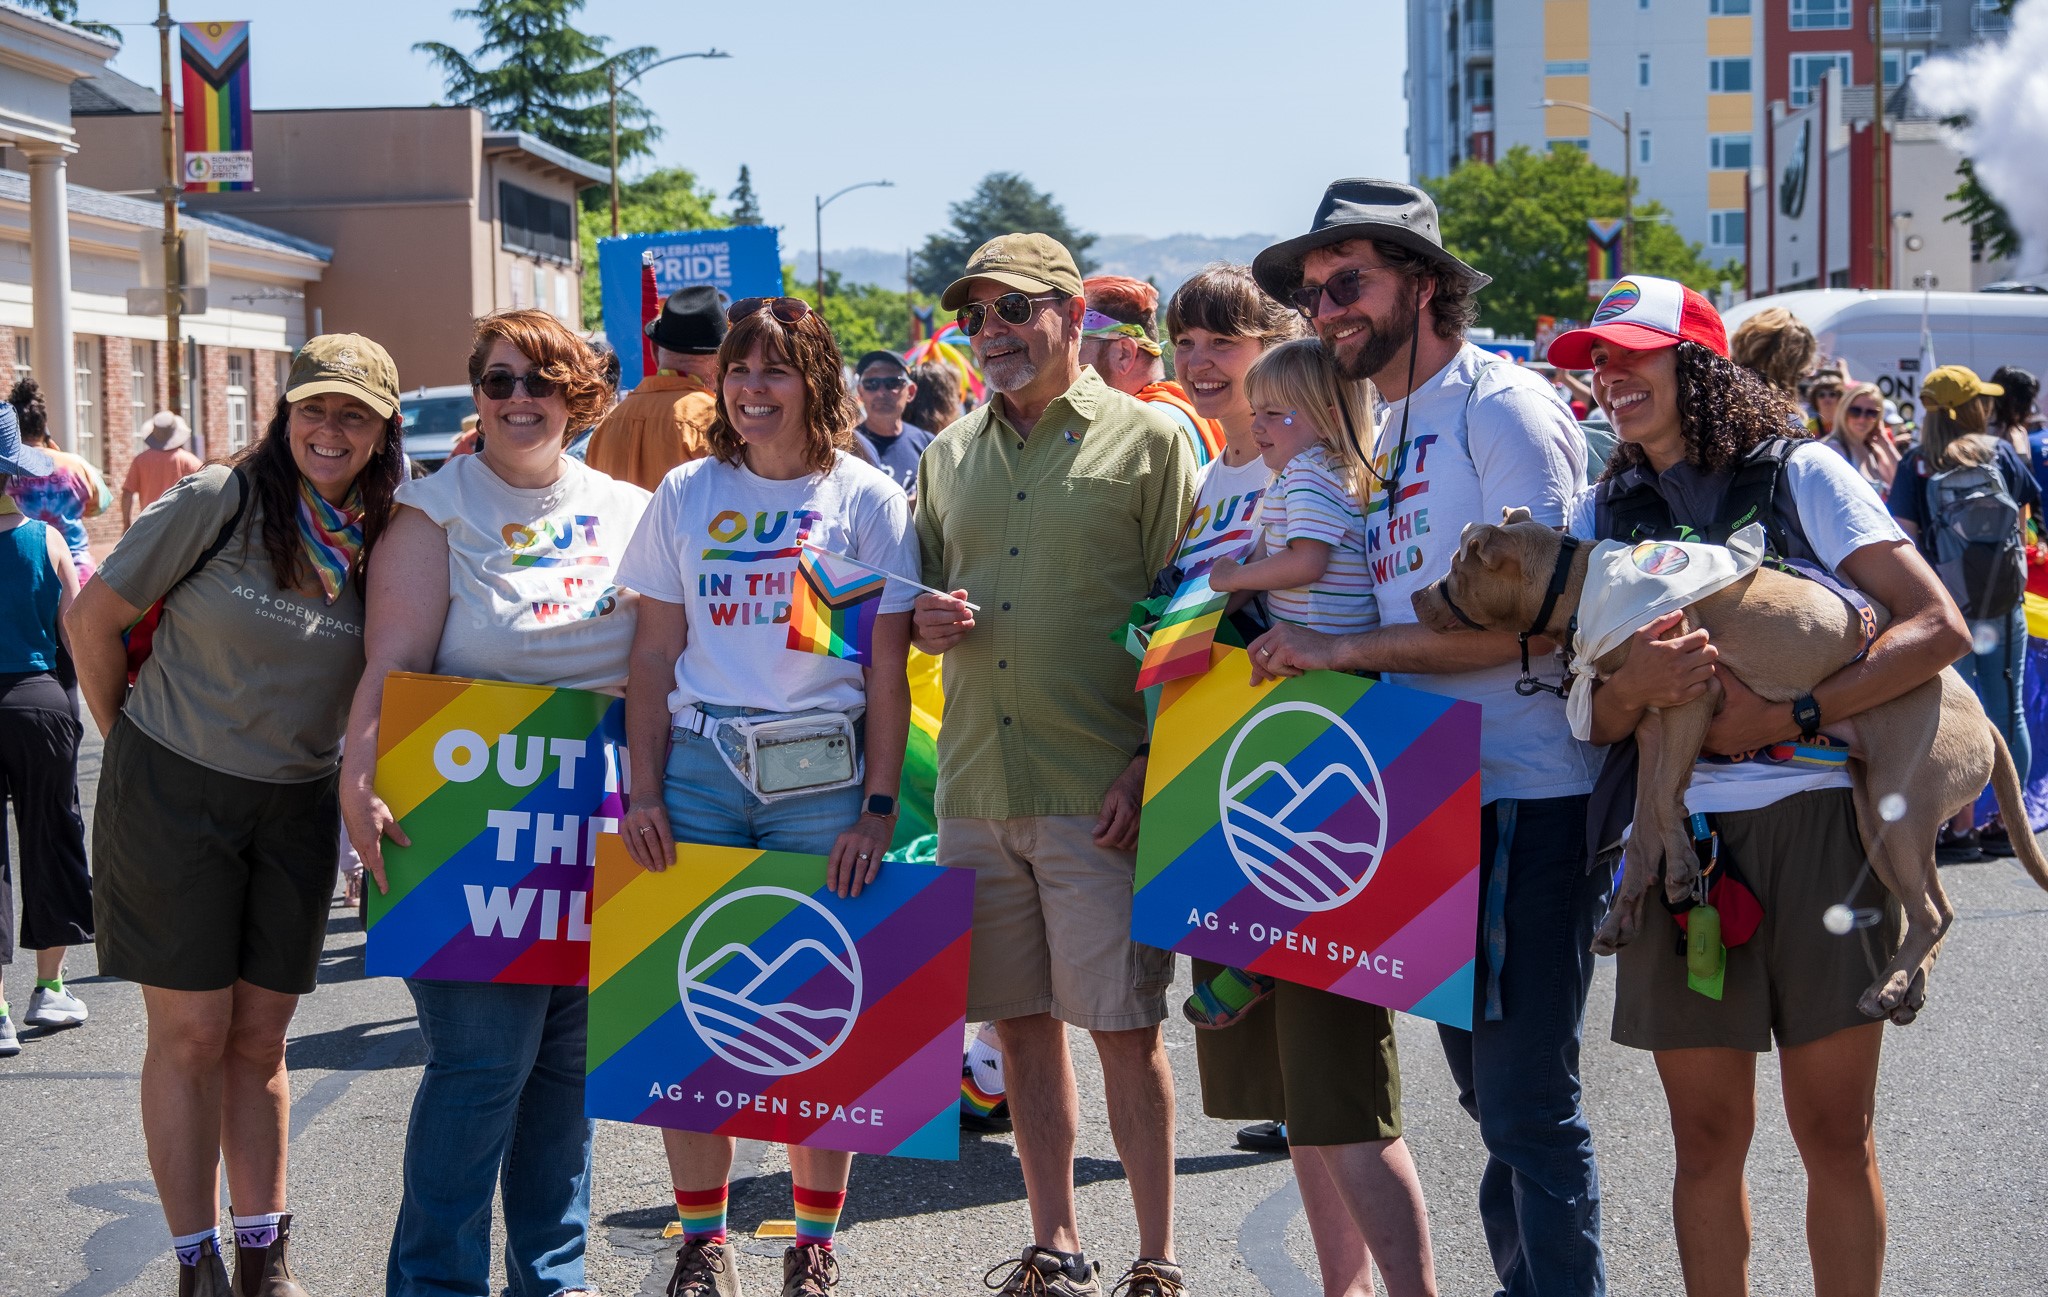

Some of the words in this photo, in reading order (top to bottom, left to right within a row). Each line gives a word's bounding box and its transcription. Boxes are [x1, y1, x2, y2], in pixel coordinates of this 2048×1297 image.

[654, 255, 731, 281] PRIDE
[1372, 434, 1439, 493] OUT
[501, 515, 600, 549] OUT
[708, 510, 823, 544] OUT
[1187, 488, 1266, 539] OUT
[1368, 525, 1381, 554] N
[1387, 508, 1430, 545] THE
[699, 573, 732, 596] IN
[1372, 544, 1424, 585] WILD
[231, 585, 255, 600] AG
[259, 593, 270, 605] +
[274, 599, 314, 622] OPEN
[316, 613, 362, 637] SPACE
[255, 608, 297, 627] SONOMA
[300, 623, 336, 639] COUNTY
[709, 601, 793, 626] WILD
[433, 729, 586, 789] OUT
[463, 884, 592, 942] WIL
[1187, 907, 1219, 931] AG
[1229, 922, 1239, 934] +
[1249, 922, 1317, 956] OPEN
[1327, 941, 1404, 980] SPACE
[649, 1082, 683, 1101] AG
[694, 1091, 705, 1103] +
[716, 1090, 787, 1115] OPEN
[799, 1100, 884, 1126] SPACE
[237, 1230, 267, 1245] AY
